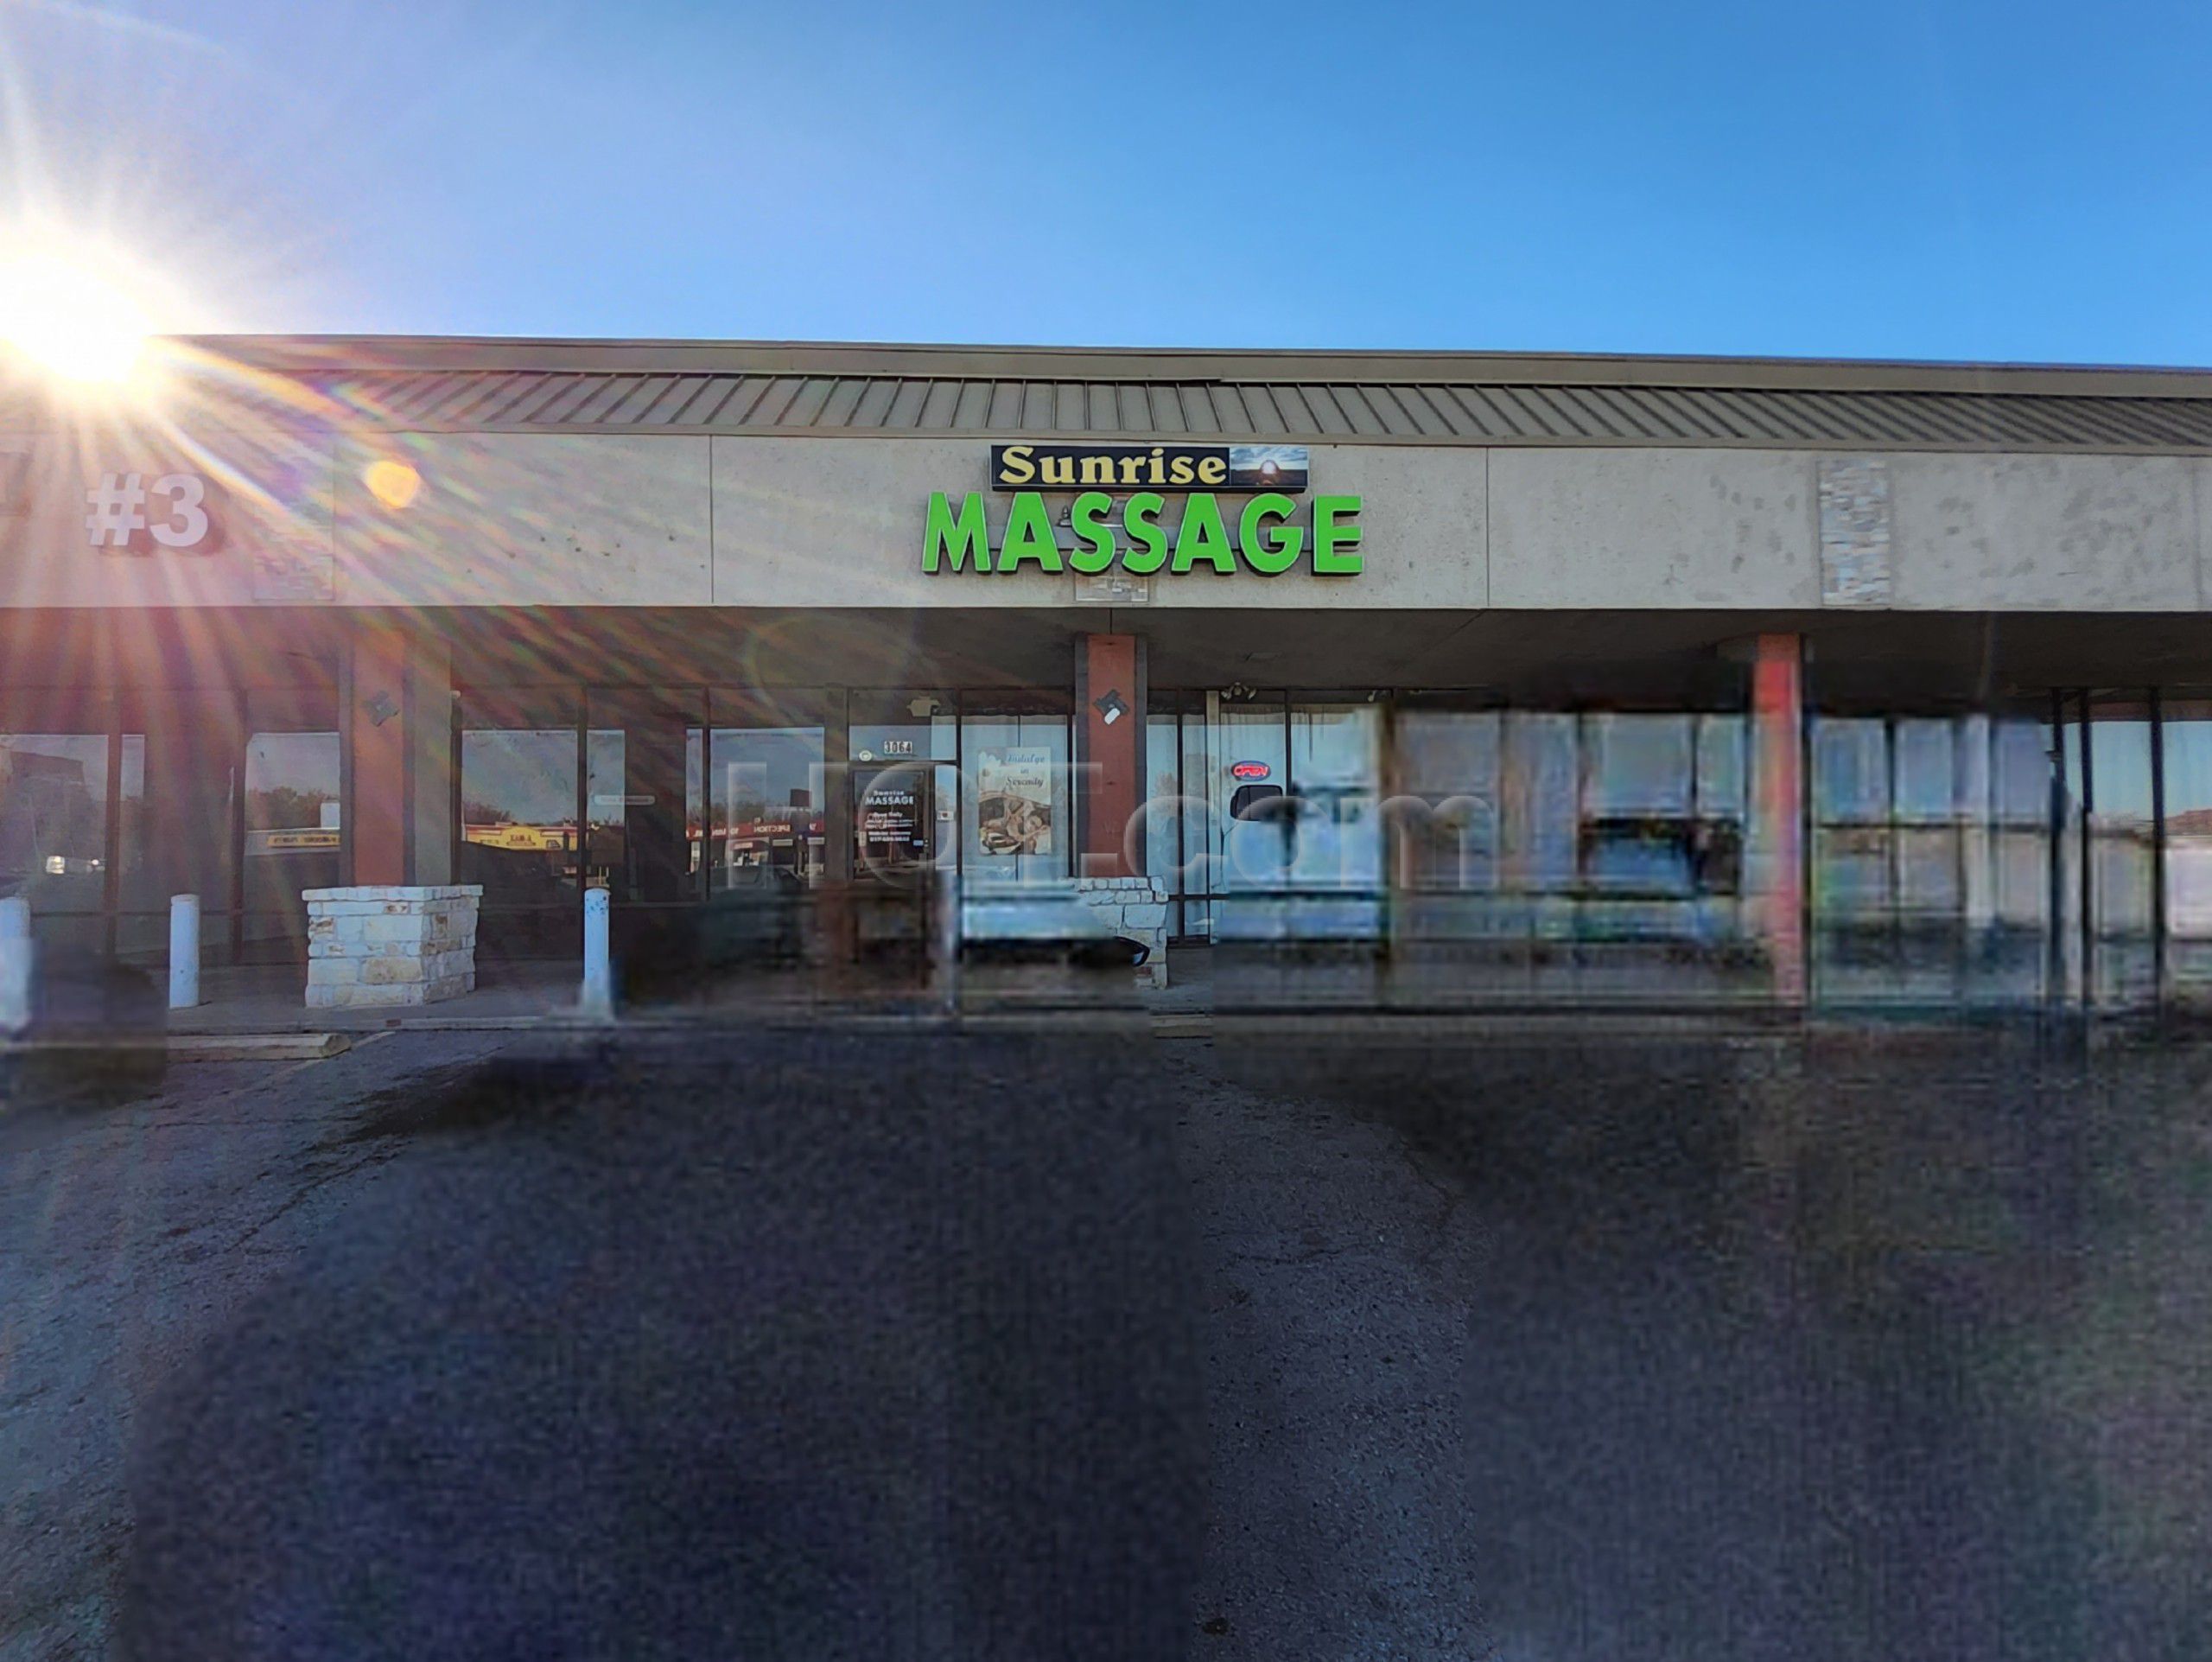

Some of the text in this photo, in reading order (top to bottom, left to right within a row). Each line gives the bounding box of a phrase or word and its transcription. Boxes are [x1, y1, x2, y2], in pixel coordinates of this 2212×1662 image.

[999, 446, 1227, 484] Sunrise
[86, 473, 208, 546] #3
[922, 492, 1363, 574] MASSAGE
[885, 742, 912, 754] 3064
[1233, 764, 1268, 777] OPEN
[864, 796, 914, 806] MASSAGE
